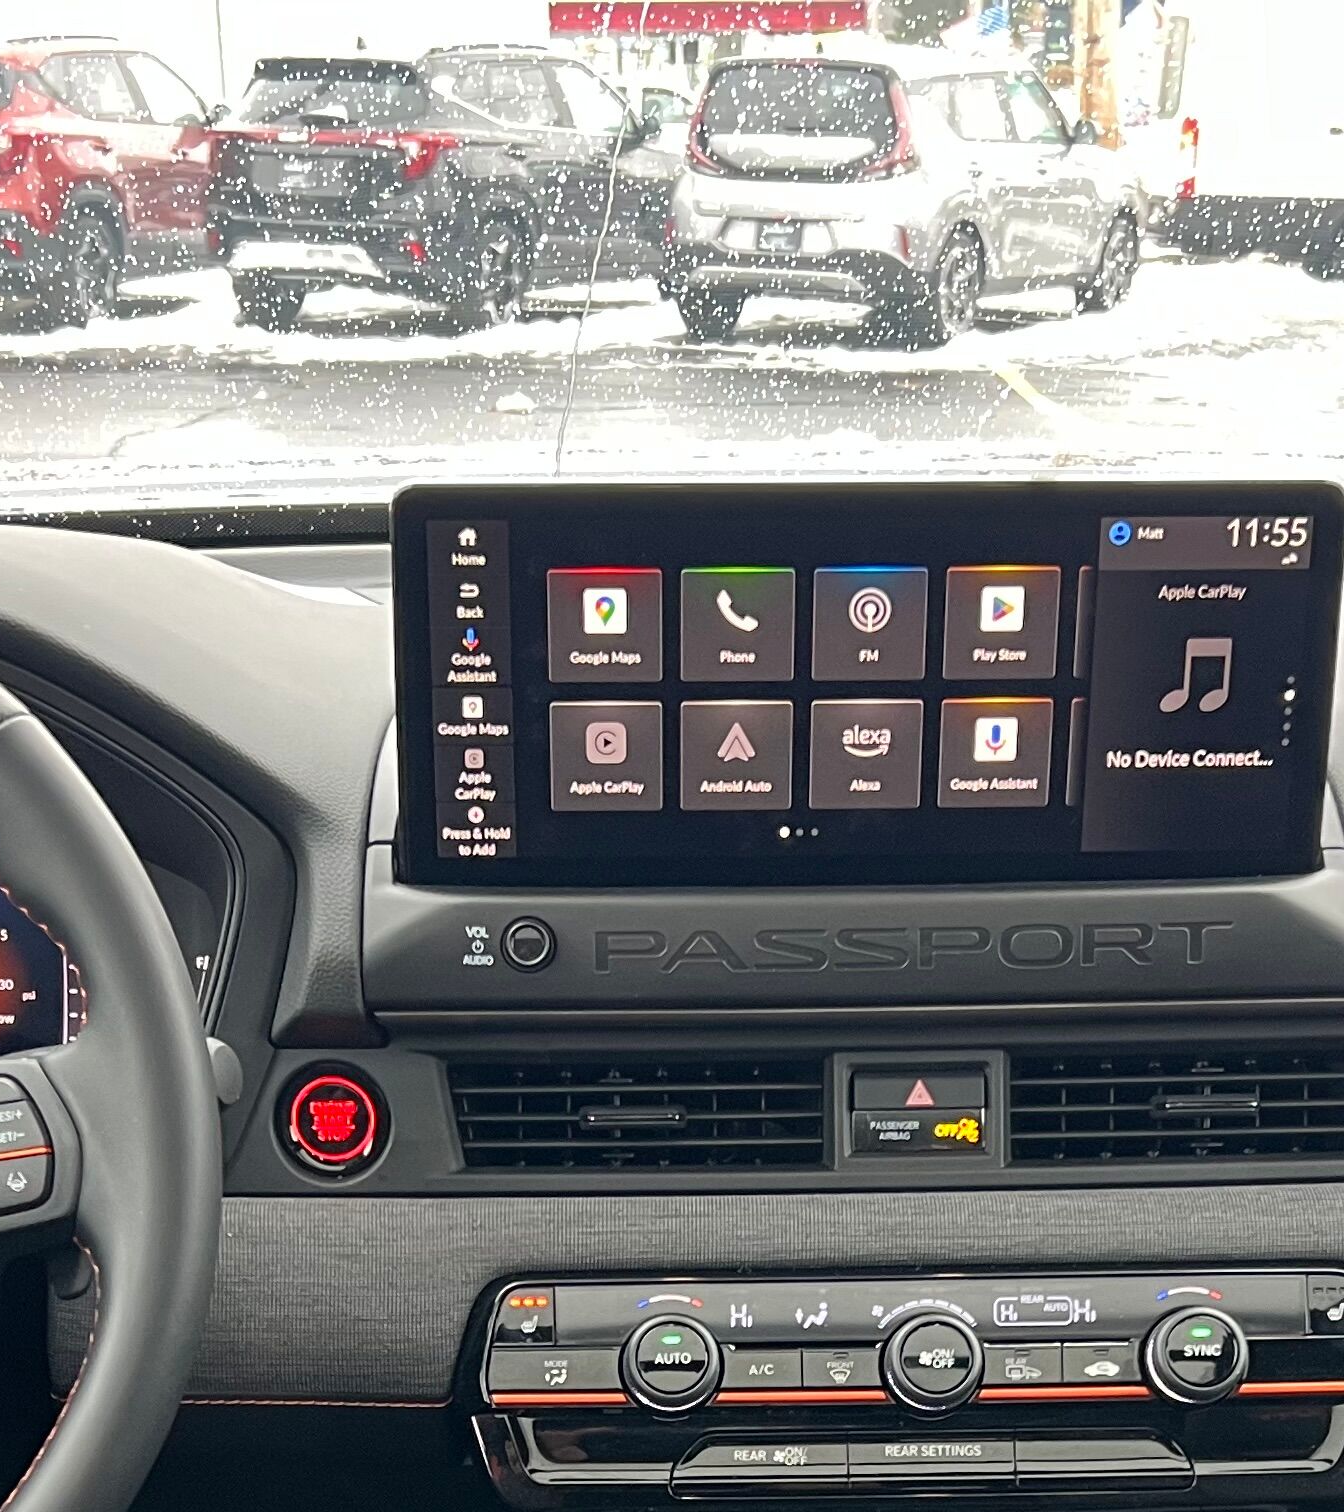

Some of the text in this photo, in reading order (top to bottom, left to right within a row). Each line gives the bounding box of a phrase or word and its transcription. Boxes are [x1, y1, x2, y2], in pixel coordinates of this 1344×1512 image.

[1137, 517, 1308, 548] Matt 11:55
[451, 553, 486, 566] Home
[1158, 583, 1247, 601] Apple CarPlay
[456, 606, 485, 619] Back
[451, 652, 492, 668] Google
[569, 651, 641, 666] Google Maps
[719, 650, 756, 664] Phone
[858, 649, 879, 662] FM
[973, 648, 1027, 663] Play Store
[447, 669, 497, 683] Assistant
[437, 722, 509, 738] Google Maps
[842, 724, 892, 746] alexa
[1106, 748, 1274, 768] No Device Connect...
[458, 771, 492, 785] Apple
[950, 777, 1038, 792] Google Assistant
[569, 780, 644, 795] Apple CarPlay
[700, 780, 772, 794] Android Auto
[849, 779, 881, 792] Alexa
[454, 788, 496, 802] CarPlay
[442, 827, 511, 841] Press & Hold
[458, 844, 497, 857] to Add
[465, 925, 489, 939] VOL
[592, 920, 1235, 973] PASSPORT
[462, 954, 494, 966] AUDIO
[22, 990, 36, 1002] psi
[869, 1120, 920, 1131] PASSENGER
[878, 1131, 911, 1142] AIRBAG
[1020, 1295, 1044, 1304] REAR
[1043, 1303, 1068, 1313] AUTO
[1183, 1344, 1222, 1358] SYNC
[543, 1360, 568, 1369] MODE
[654, 1352, 692, 1365] AUTO
[932, 1358, 955, 1369] OFF
[748, 1363, 775, 1376] A/C
[826, 1361, 854, 1370] FRONT
[733, 1449, 767, 1462] REAR
[885, 1444, 982, 1457] REAR SETTINGS
[784, 1456, 807, 1466] OFF
